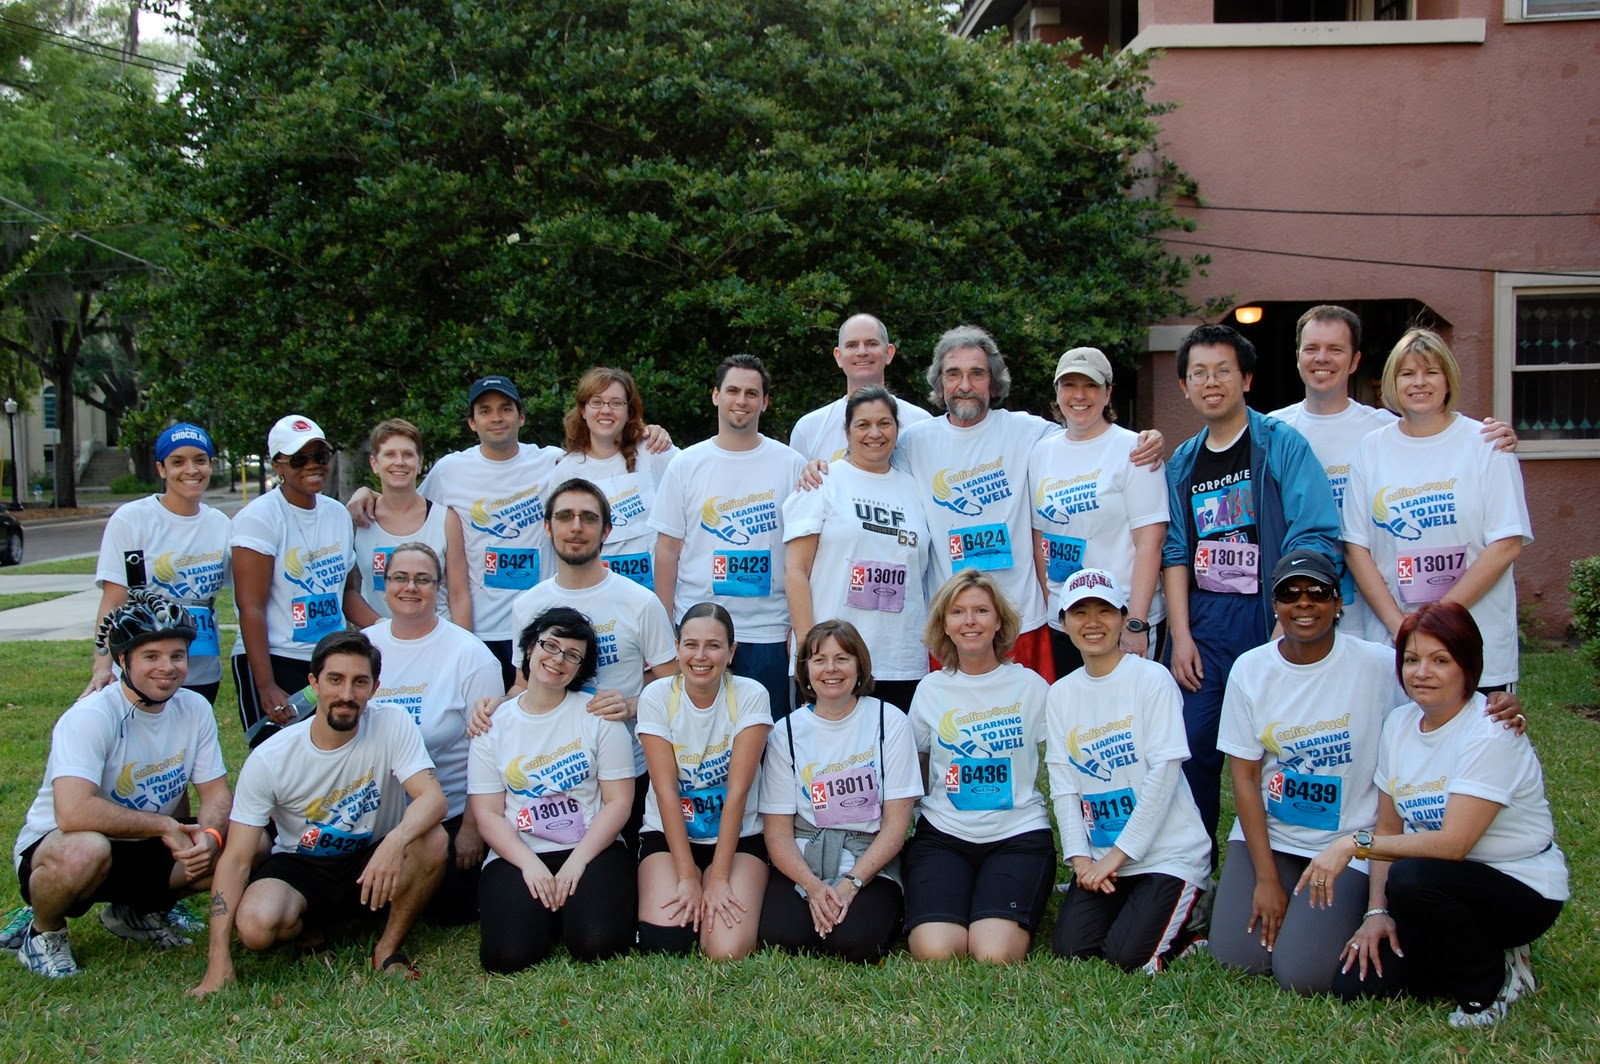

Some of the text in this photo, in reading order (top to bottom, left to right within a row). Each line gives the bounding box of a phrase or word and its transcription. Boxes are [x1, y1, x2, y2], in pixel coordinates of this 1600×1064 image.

[962, 470, 1005, 490] LEARNING
[970, 478, 1009, 497] TO LIVE
[1191, 469, 1250, 494] CORPORATE
[979, 488, 1012, 506] WELL
[1054, 482, 1097, 498] LEARNING
[1060, 490, 1096, 506] TO LIVE
[500, 496, 539, 516] LEARNING
[612, 494, 640, 510] LEARNING
[628, 500, 643, 510] LIVE
[732, 502, 775, 518] LEARNING
[852, 498, 890, 508] PROPERTY
[1065, 500, 1100, 516] WELL
[1400, 493, 1454, 510] LEARNING
[1410, 502, 1456, 518] TO LIVE
[509, 503, 543, 522] TO LIVE
[516, 511, 545, 529] WELL
[624, 506, 645, 518] WELL
[740, 511, 776, 526] TO LIVE
[854, 503, 906, 528] UCF
[747, 520, 778, 535] WELL
[1418, 514, 1457, 529] WELL
[898, 529, 919, 548] 63
[950, 538, 962, 554] 5K
[962, 529, 1006, 551] 6424
[1050, 542, 1082, 562] 6435
[1197, 549, 1256, 567] 5K 13013
[315, 562, 346, 578] TO LIVE
[375, 555, 384, 568] 5K
[486, 554, 535, 569] 5K 6421
[611, 558, 649, 575] 6426
[714, 556, 768, 574] 5K 6423
[1398, 552, 1465, 577] 5K 13017
[195, 576, 207, 584] TO
[852, 568, 906, 586] 5K 13010
[1069, 574, 1114, 592] INDIANA
[293, 598, 338, 621] 5K 6428
[598, 654, 620, 668] ELL
[972, 716, 1022, 732] LEARNING
[981, 726, 1023, 741] TO LIVE
[1092, 732, 1132, 751] LEARNING
[1294, 731, 1350, 750] LEARNING
[989, 738, 1024, 752] WELL
[1100, 742, 1134, 760] TO LIVE
[1306, 742, 1351, 758] TO LIVE
[540, 752, 586, 777] LEARNING
[1312, 753, 1352, 768] WELL
[550, 760, 590, 784] TO LIVE
[558, 770, 590, 791] WELL
[698, 772, 713, 782] TO
[962, 764, 1008, 784] 6436
[152, 784, 167, 794] TO
[812, 786, 826, 802] 5K
[826, 774, 874, 796] 13011
[1270, 775, 1337, 804] 5K 6439
[692, 794, 724, 814] 641
[1091, 796, 1134, 822] 6419
[1405, 795, 1444, 808] LEARNING
[517, 812, 532, 828] 5K
[530, 798, 578, 821] 13016
[1412, 810, 1424, 821] TO
[302, 830, 316, 845] 5K
